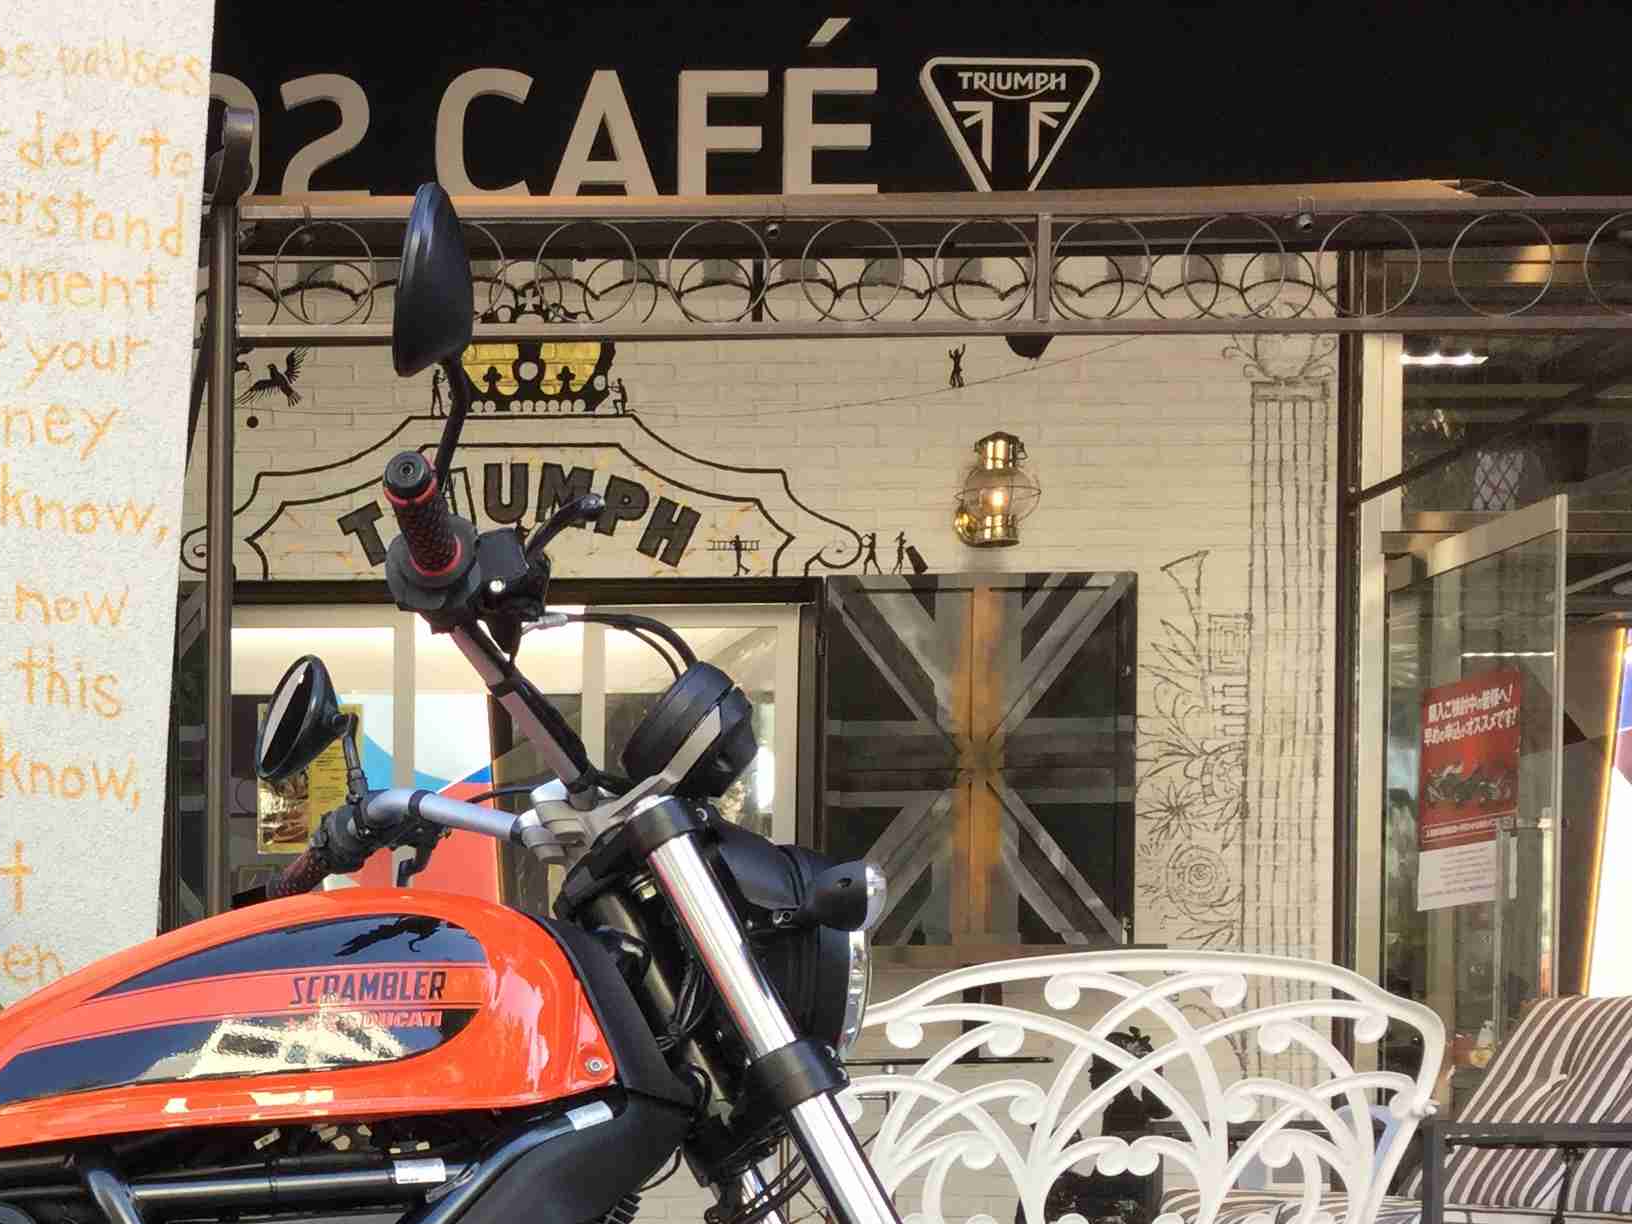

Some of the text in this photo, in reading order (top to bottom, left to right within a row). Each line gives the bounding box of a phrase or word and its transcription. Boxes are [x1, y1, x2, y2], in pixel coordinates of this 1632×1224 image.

[435, 18, 880, 196] CAFÉ
[957, 70, 1067, 99] TRIUMPH
[138, 128, 194, 178] to
[18, 335, 150, 390] your
[0, 463, 170, 546] know,
[338, 460, 702, 568] TIUMPH
[14, 583, 132, 630] now
[13, 642, 126, 720] this
[290, 971, 448, 1005] SCRAMBLER
[359, 1009, 443, 1029] DUCATI
